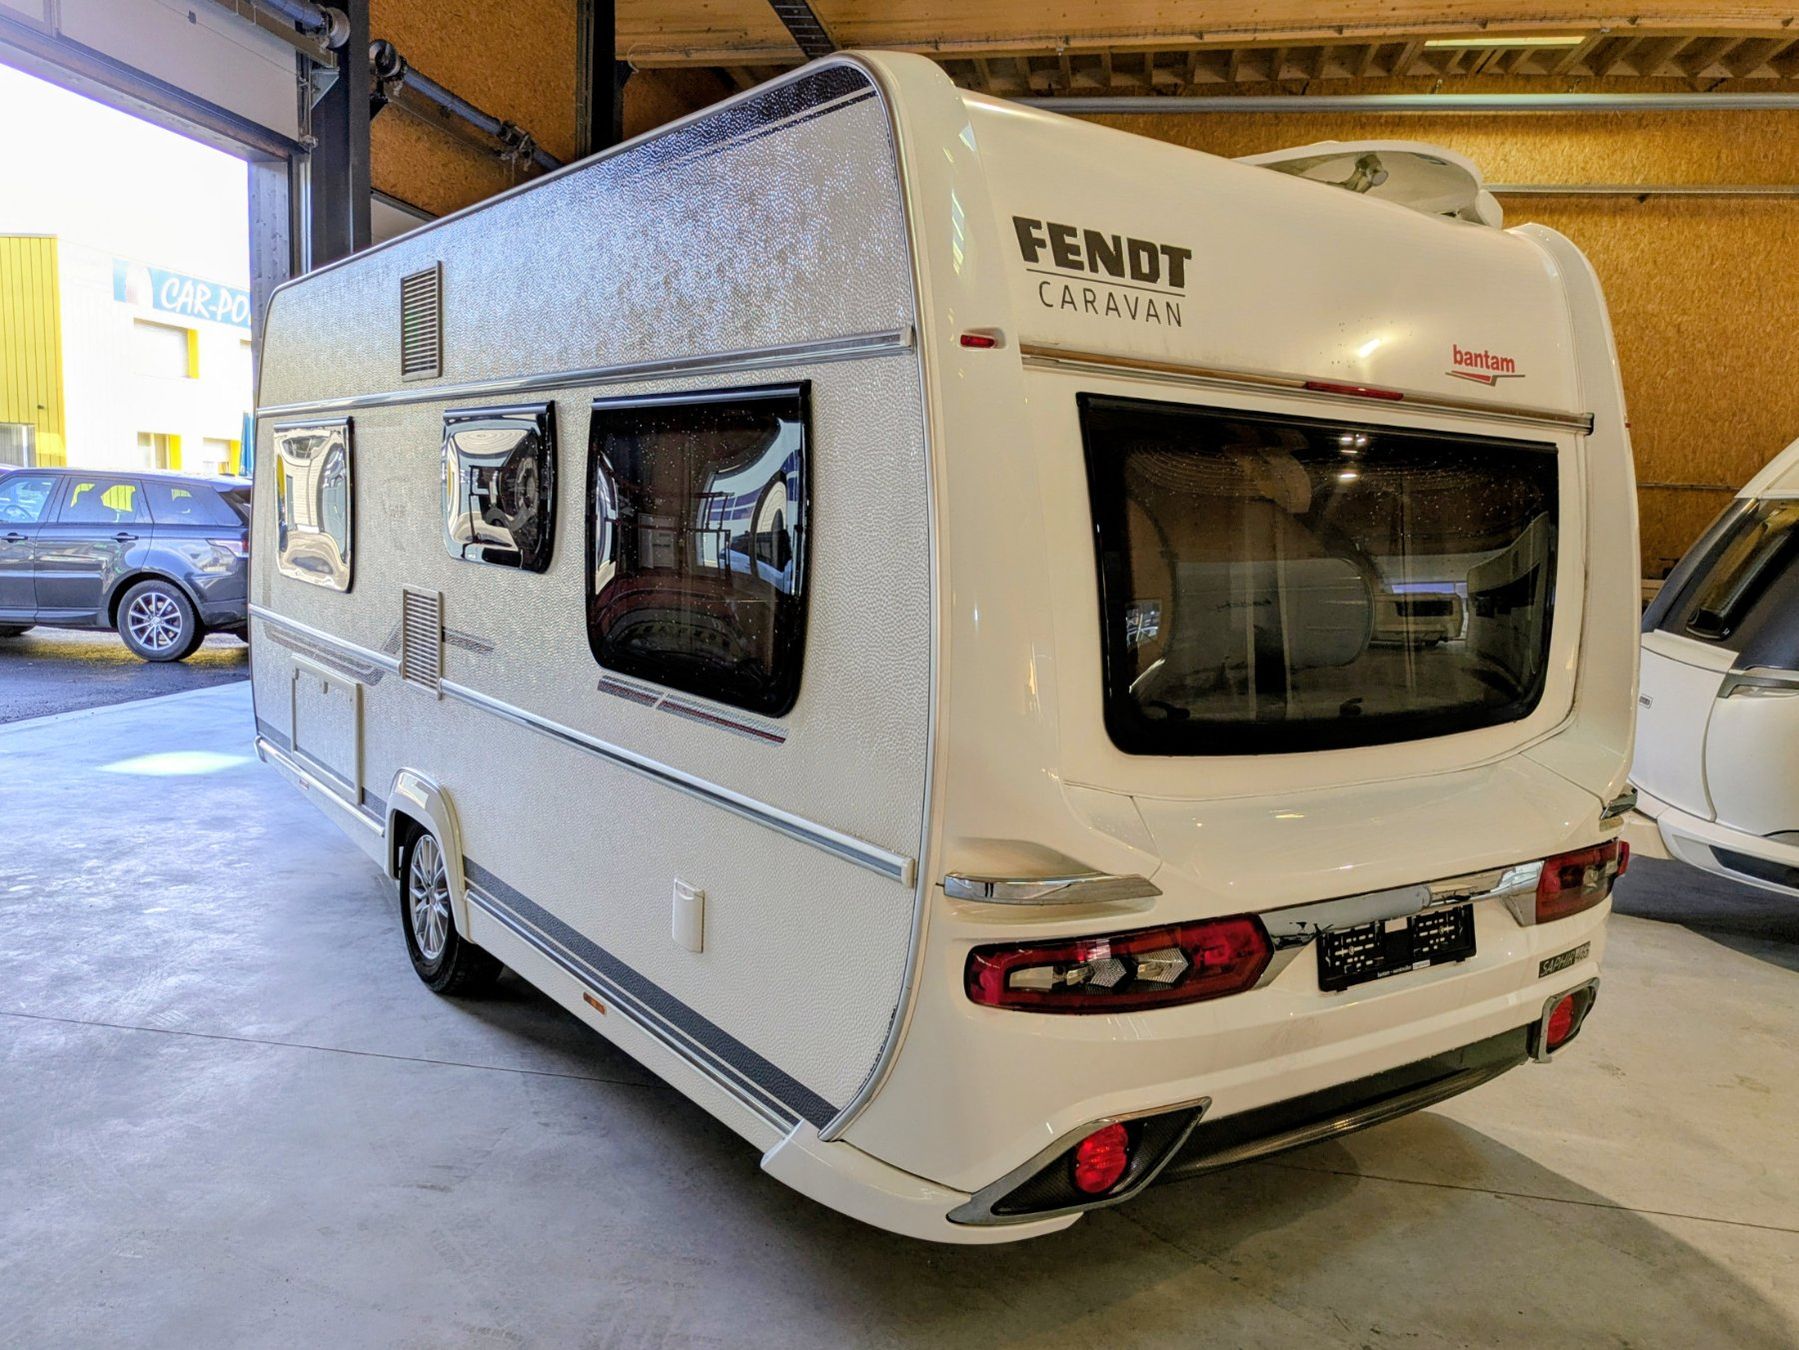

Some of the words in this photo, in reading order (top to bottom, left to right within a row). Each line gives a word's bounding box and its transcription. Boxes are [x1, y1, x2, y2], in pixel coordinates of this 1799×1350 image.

[1012, 215, 1192, 289] FENDT
[161, 277, 252, 326] CAR-PO
[1038, 280, 1183, 328] CARAVAN
[1452, 343, 1515, 374] bantam
